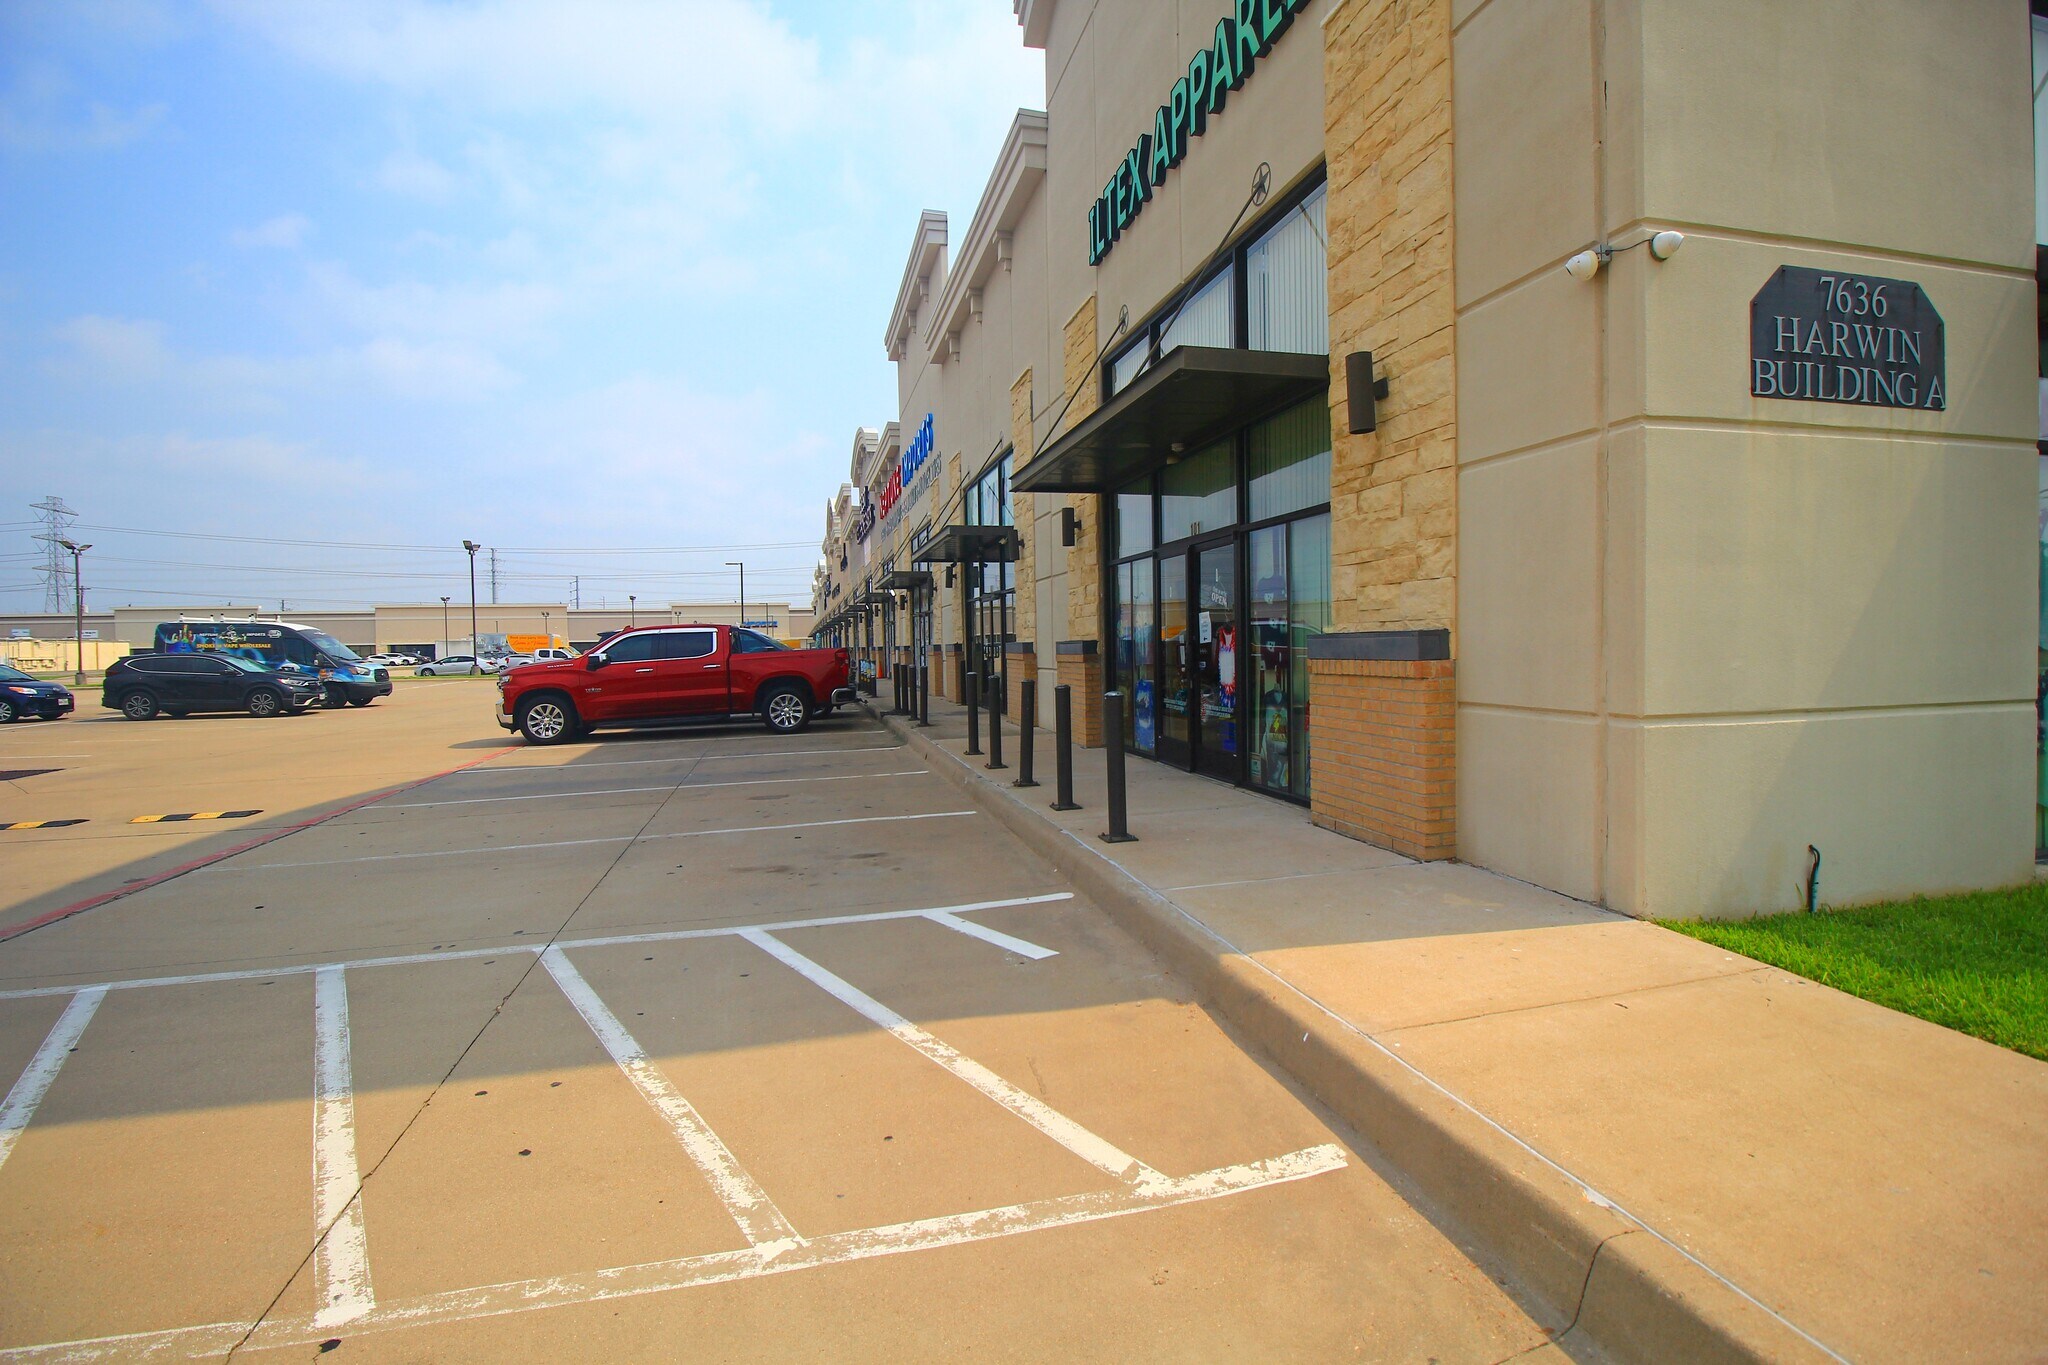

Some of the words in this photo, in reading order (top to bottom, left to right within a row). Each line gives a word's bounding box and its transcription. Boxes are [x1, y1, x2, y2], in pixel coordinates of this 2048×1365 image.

[1089, 134, 1152, 266] ILTEX
[1151, 0, 1311, 187] APPAR
[1819, 276, 1887, 318] 7636
[1773, 315, 1921, 365] HARWIN
[1752, 358, 1918, 407] BUILDING
[1923, 375, 1946, 409] A
